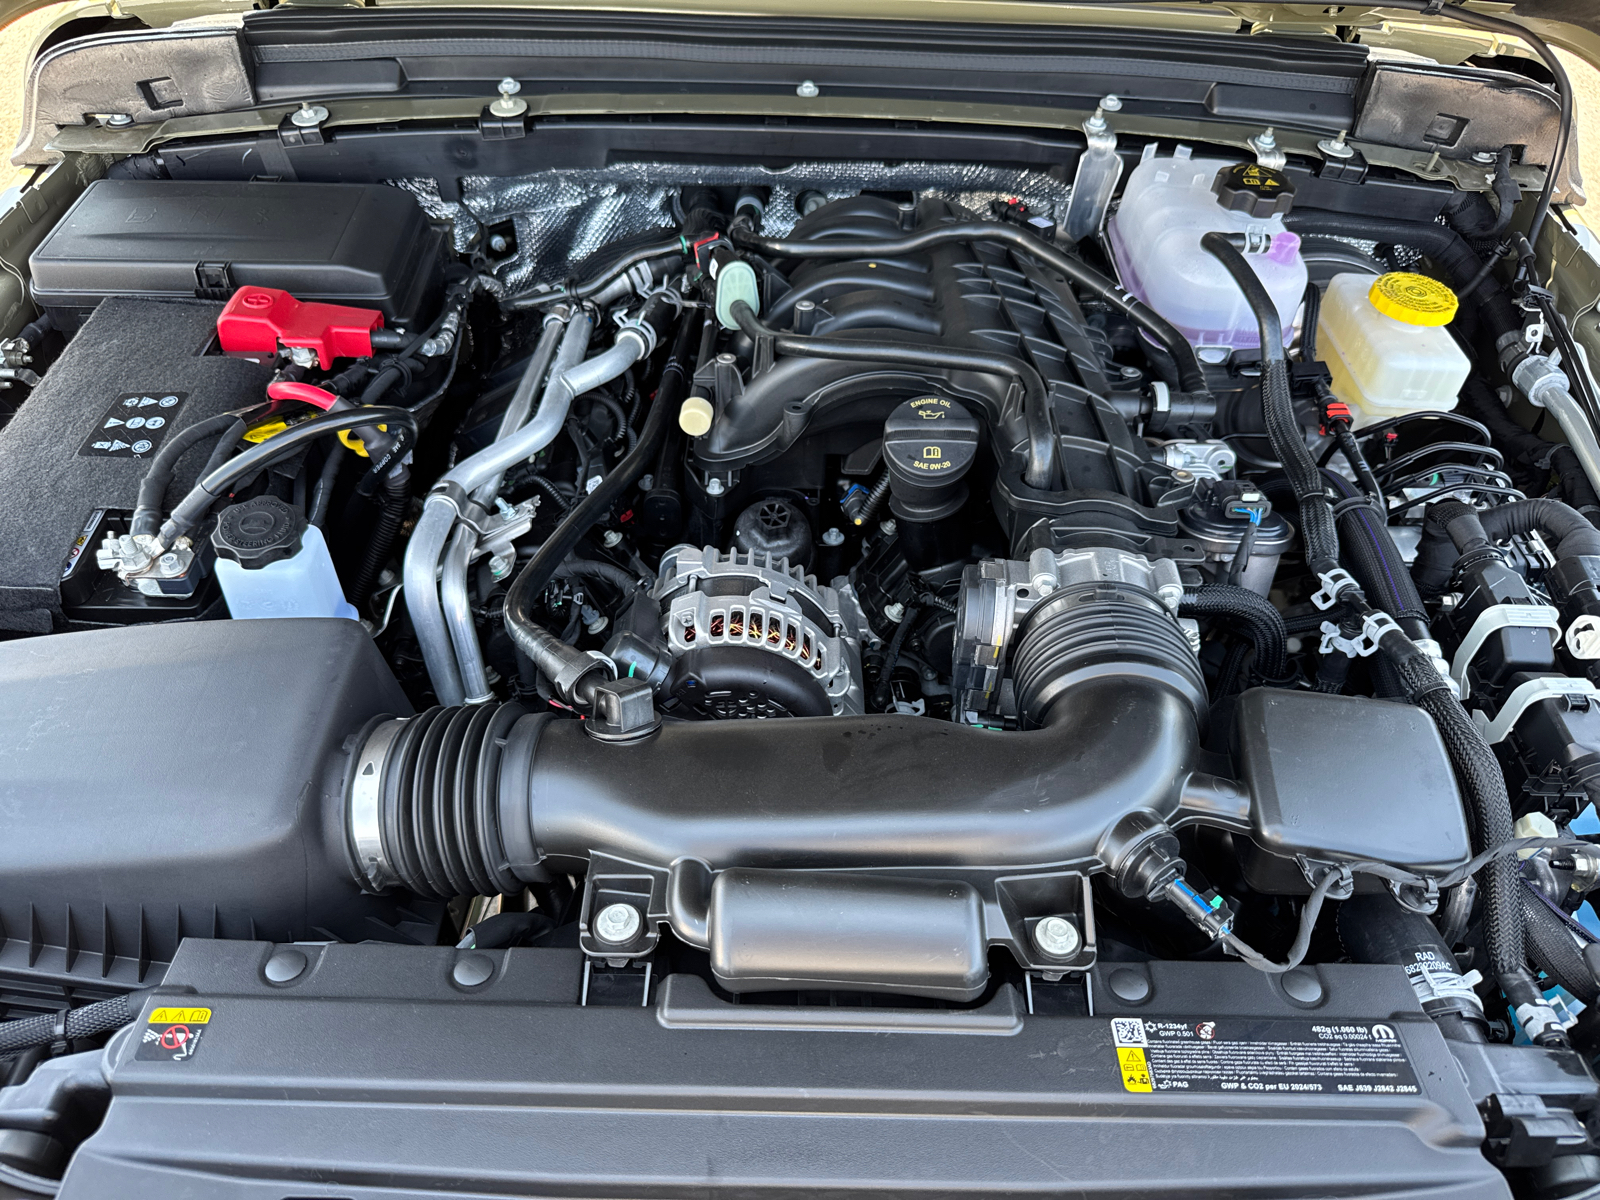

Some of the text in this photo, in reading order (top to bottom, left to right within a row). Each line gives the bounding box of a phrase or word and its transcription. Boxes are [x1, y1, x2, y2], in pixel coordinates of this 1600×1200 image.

[910, 398, 952, 408] ENGINE OIL
[372, 454, 391, 474] COPPER
[913, 460, 952, 470] SAE 0W-20
[250, 500, 289, 514] APPROVED
[234, 537, 274, 547] STEERING
[1414, 951, 1436, 962] RAD
[1312, 1025, 1331, 1034] 482g
[1356, 1026, 1368, 1034] lb)
